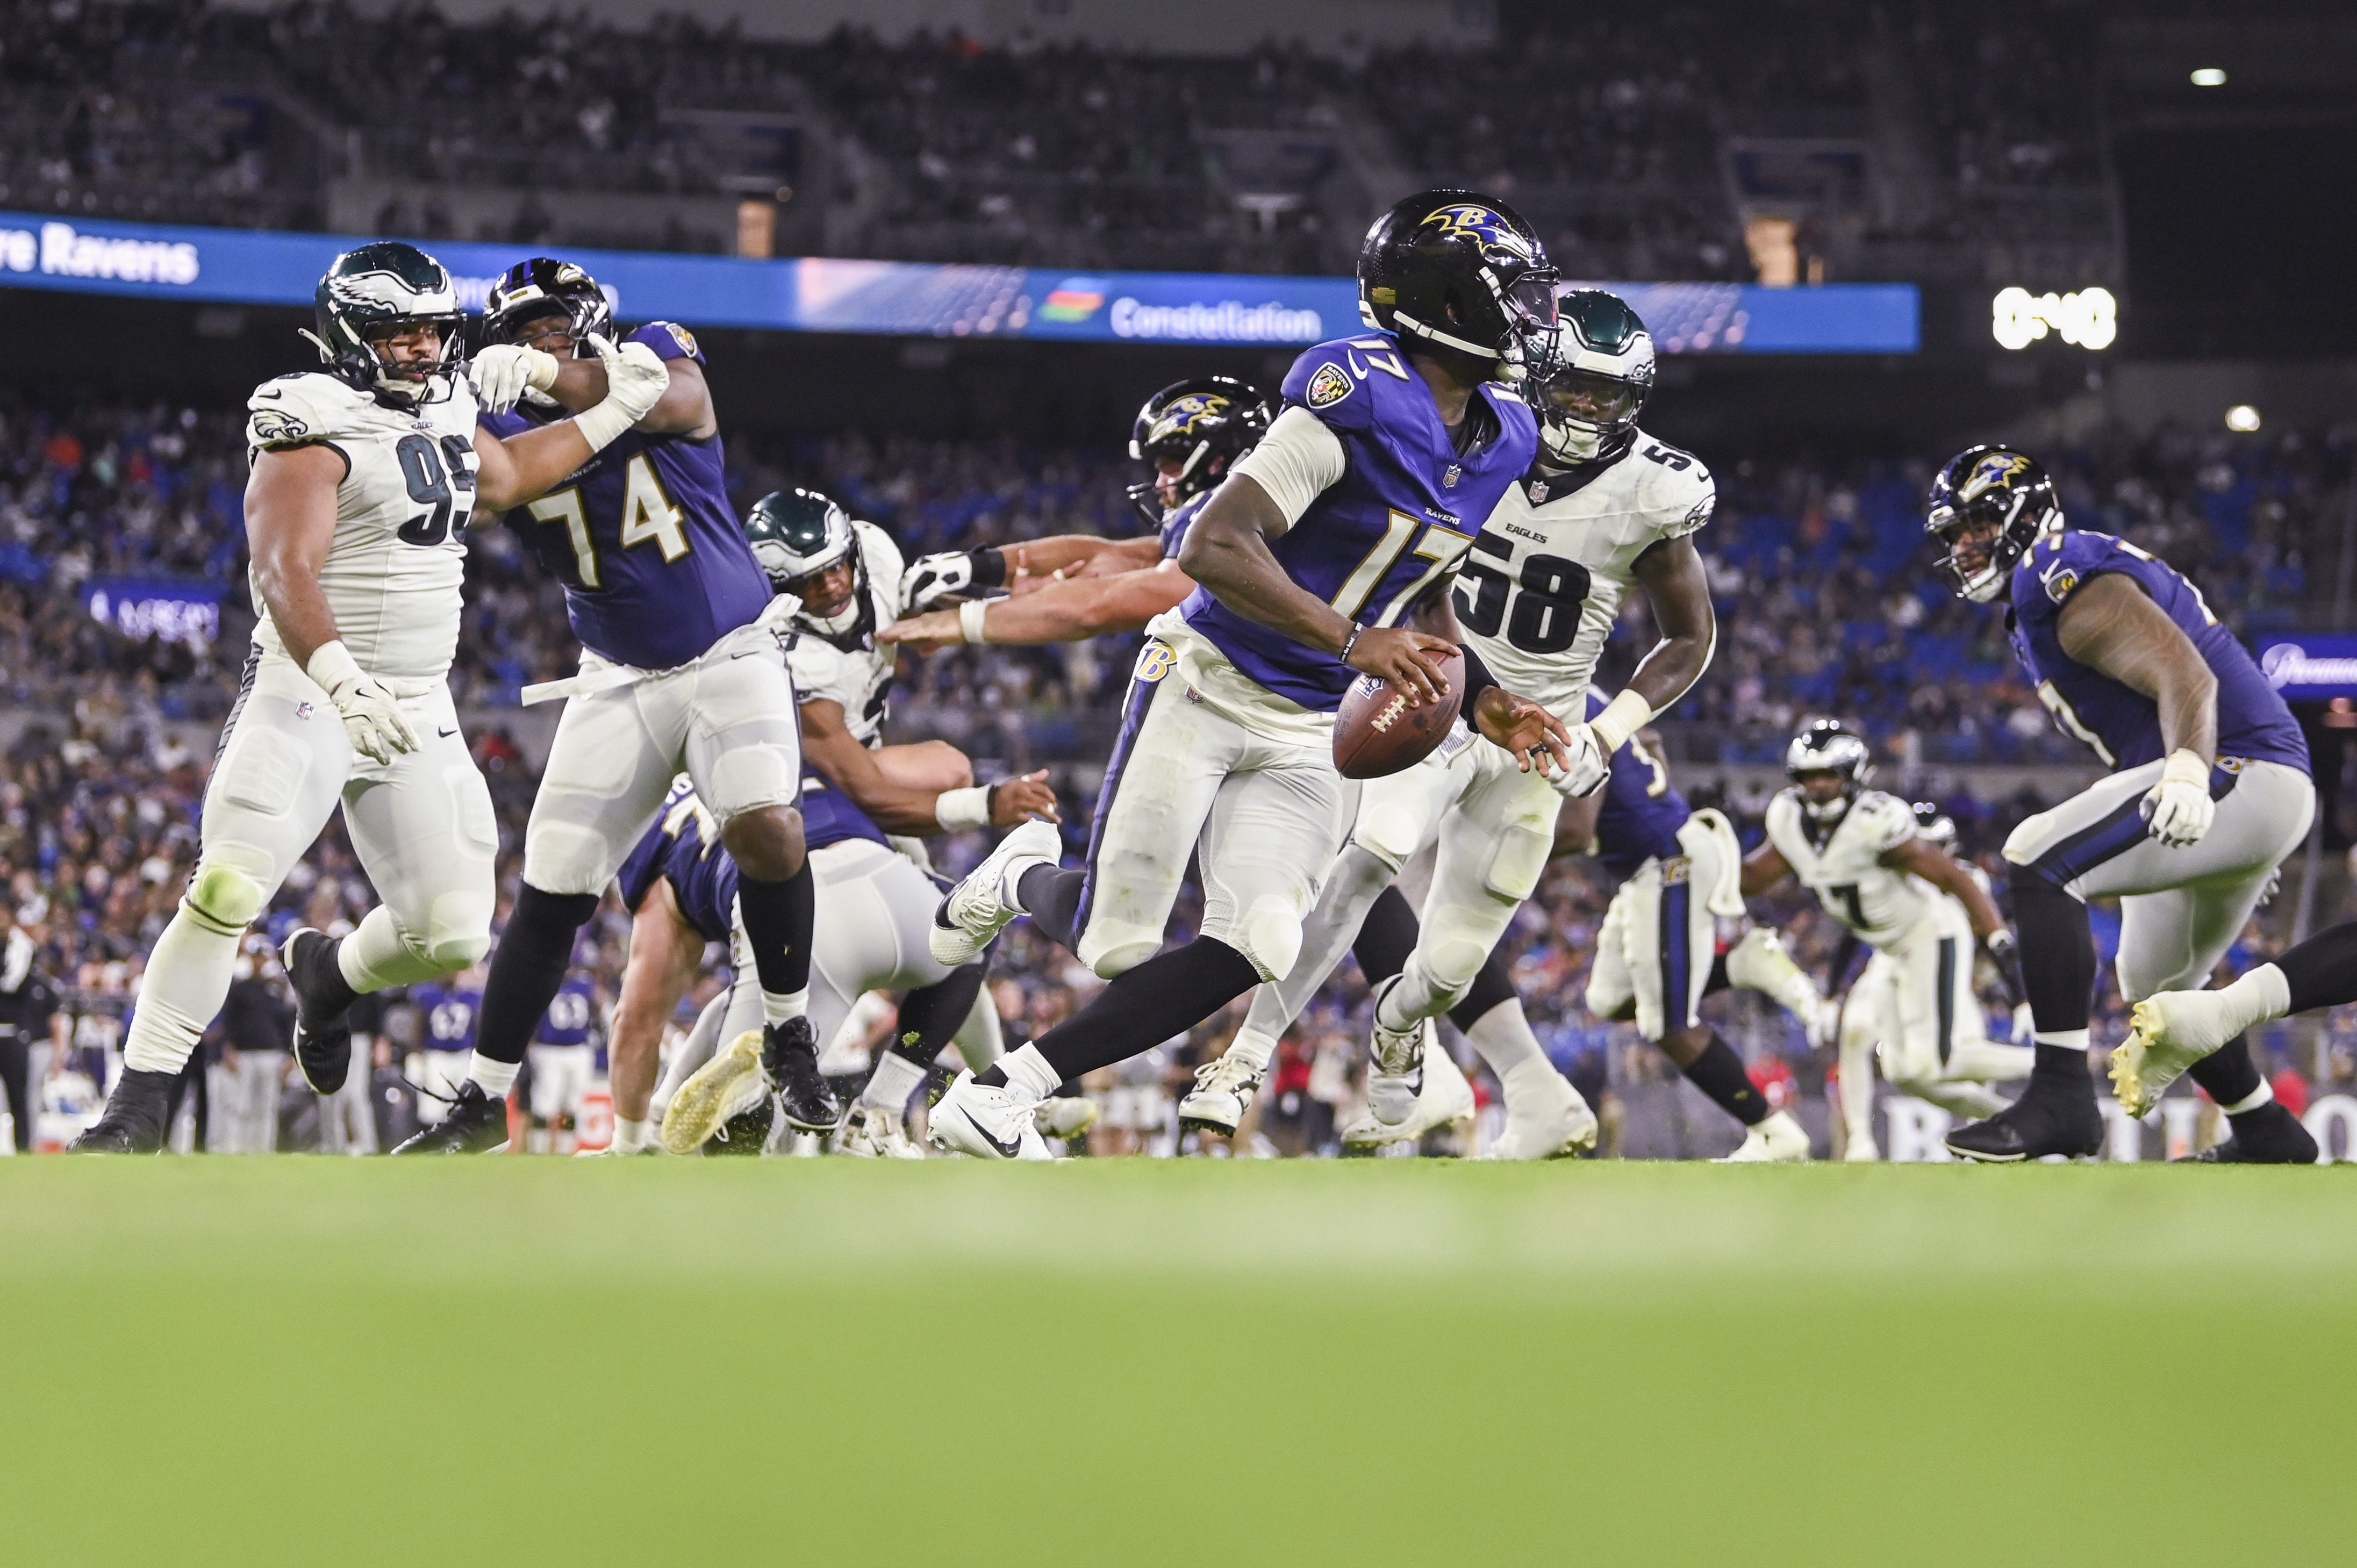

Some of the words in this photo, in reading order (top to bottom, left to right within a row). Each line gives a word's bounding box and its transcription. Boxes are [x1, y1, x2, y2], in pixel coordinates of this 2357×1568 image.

[40, 221, 199, 285] Ravens
[1111, 297, 1322, 342] Constellation
[1326, 365, 1349, 389] RAVENS
[1348, 339, 1411, 382] 17
[564, 459, 602, 481] AVENS
[1641, 440, 1700, 472] 5
[396, 434, 478, 546] 95
[527, 450, 691, 588] 74
[1425, 507, 1461, 525] RAVENS
[1506, 522, 1548, 544] EAGLES
[1330, 507, 1476, 629] 17
[1450, 528, 1592, 654] 58
[1134, 642, 1178, 683] B
